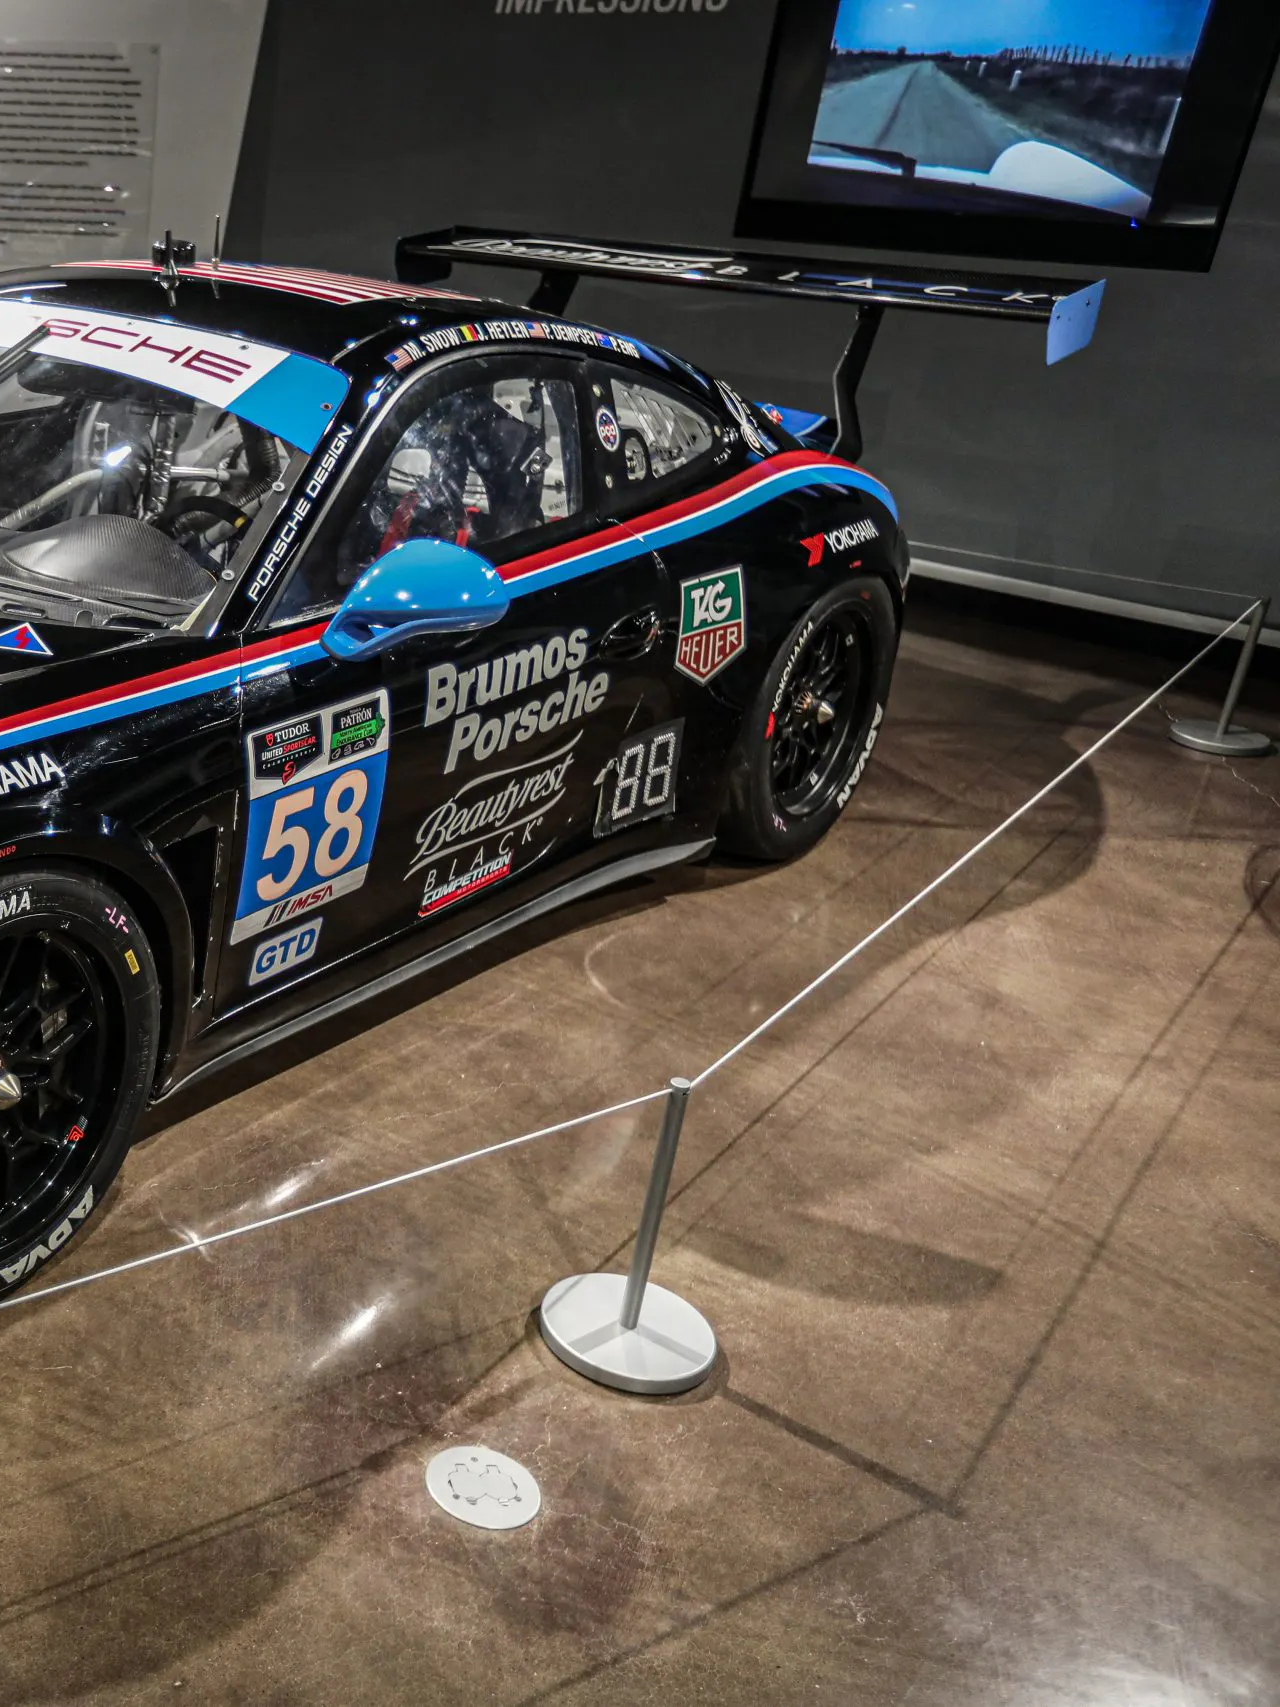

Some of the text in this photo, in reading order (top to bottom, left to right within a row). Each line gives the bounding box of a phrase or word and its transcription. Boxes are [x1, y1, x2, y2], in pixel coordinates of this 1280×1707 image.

[404, 328, 461, 361] M. SNOW
[475, 320, 530, 341] J. HEYLEN
[542, 323, 600, 347] P. DEMPSEY
[608, 336, 641, 359] P. ENG
[248, 424, 354, 601] PORSCHE DESIGN
[823, 518, 879, 553] YOKOHAMA
[690, 579, 733, 628] TAG
[680, 626, 739, 674] HEUER
[425, 628, 588, 728] Brumos
[274, 722, 310, 743] TUDOR
[340, 708, 373, 729] PATRÓN
[444, 670, 609, 775] Porsche
[261, 736, 317, 761] UNITED SPORTSCAR
[838, 702, 884, 810] ADVAN
[410, 751, 576, 865] Beautyrest
[256, 769, 368, 901] 58
[287, 884, 333, 917] IMSA
[421, 852, 512, 906] COMPETITION
[255, 927, 317, 975] GTD
